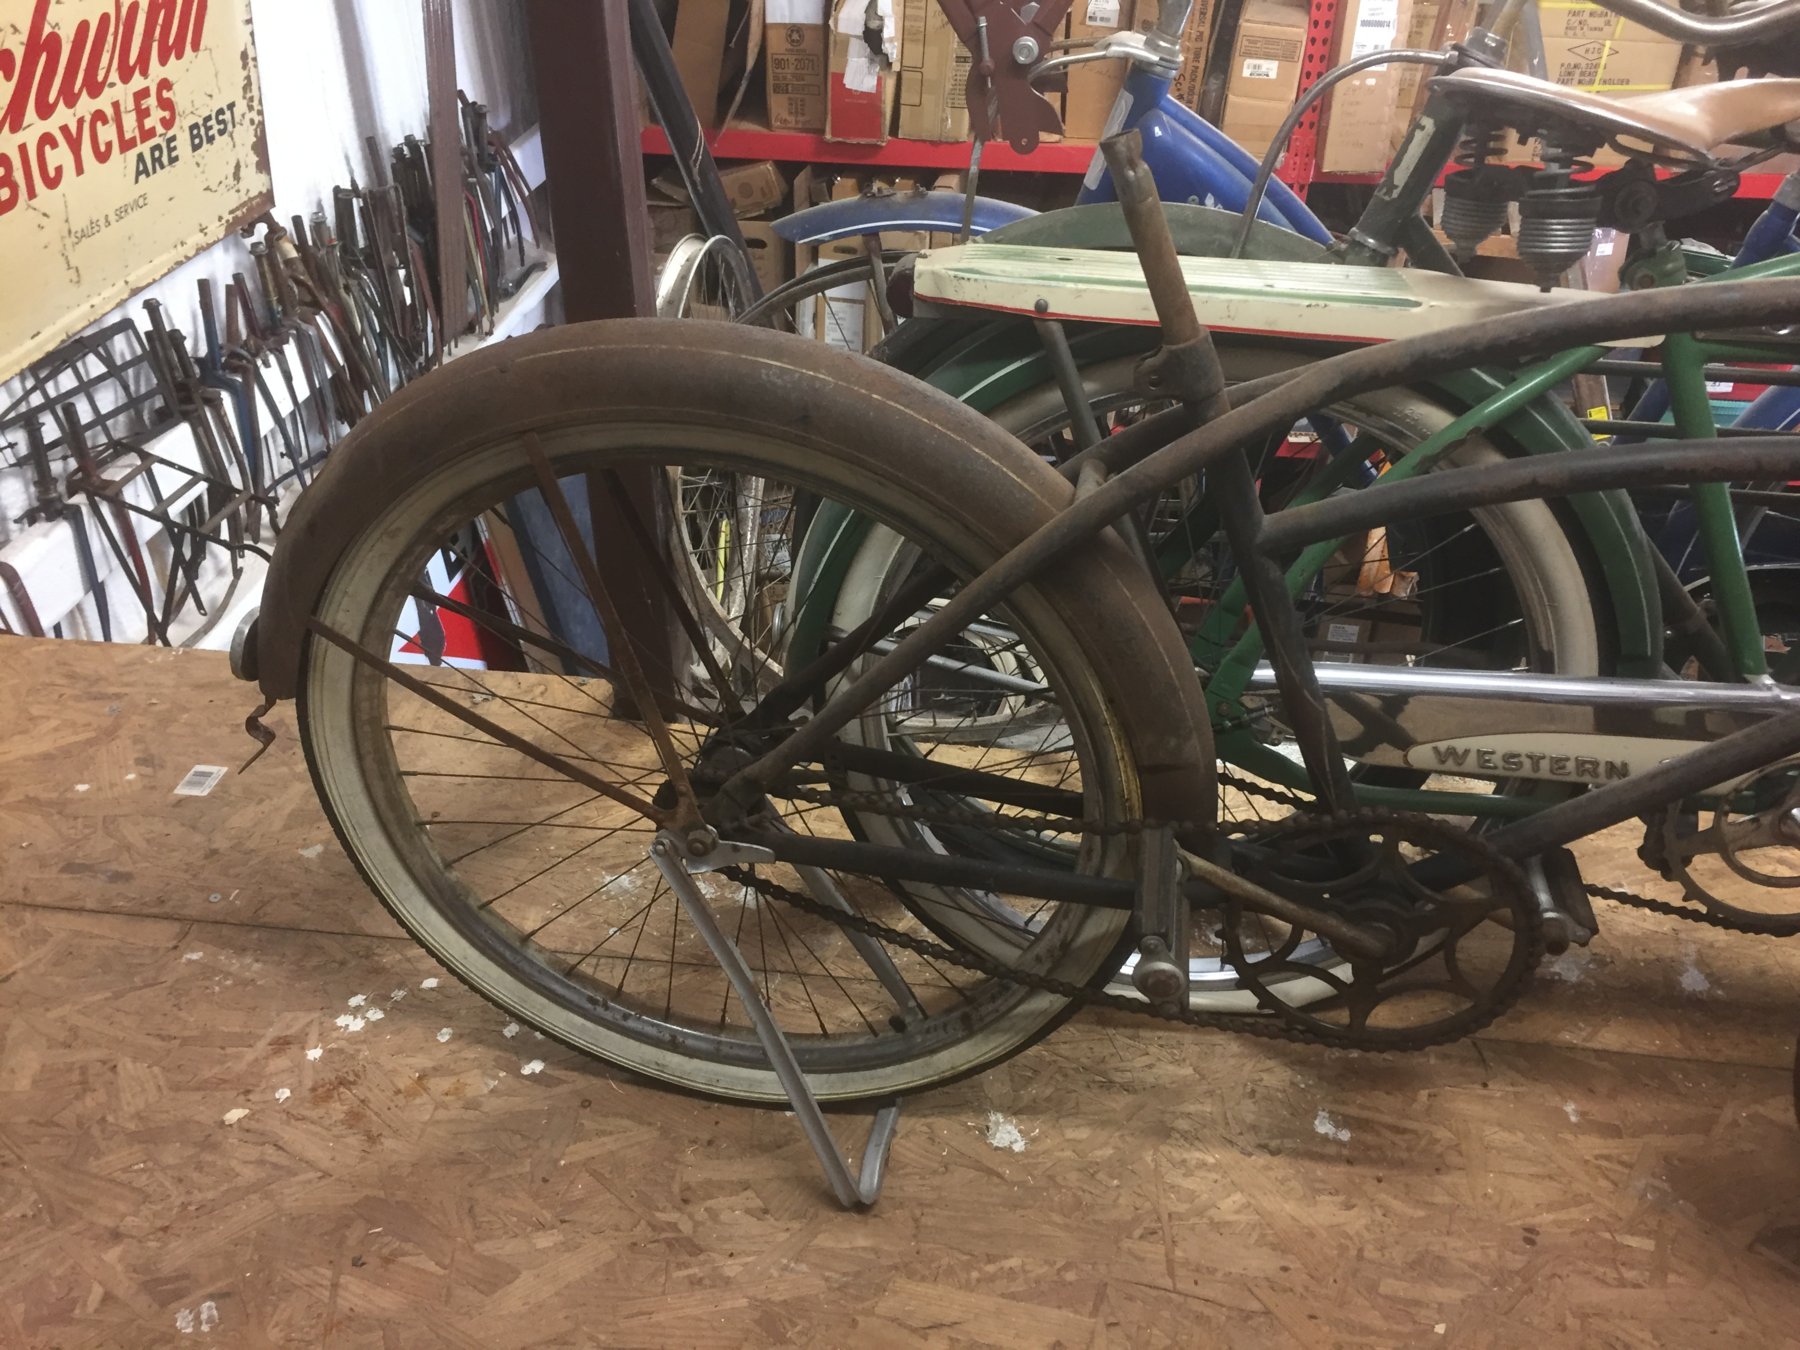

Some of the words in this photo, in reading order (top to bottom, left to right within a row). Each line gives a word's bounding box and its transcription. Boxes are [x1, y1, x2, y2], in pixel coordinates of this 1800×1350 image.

[773, 57, 815, 71] 901-2071
[0, 77, 177, 217] BICYCLES
[134, 134, 180, 185] ARE
[188, 101, 237, 154] BEST
[74, 218, 101, 246] SALES
[104, 214, 111, 228] &
[114, 192, 148, 223] SERVICE
[1432, 745, 1631, 780] WESTERN
